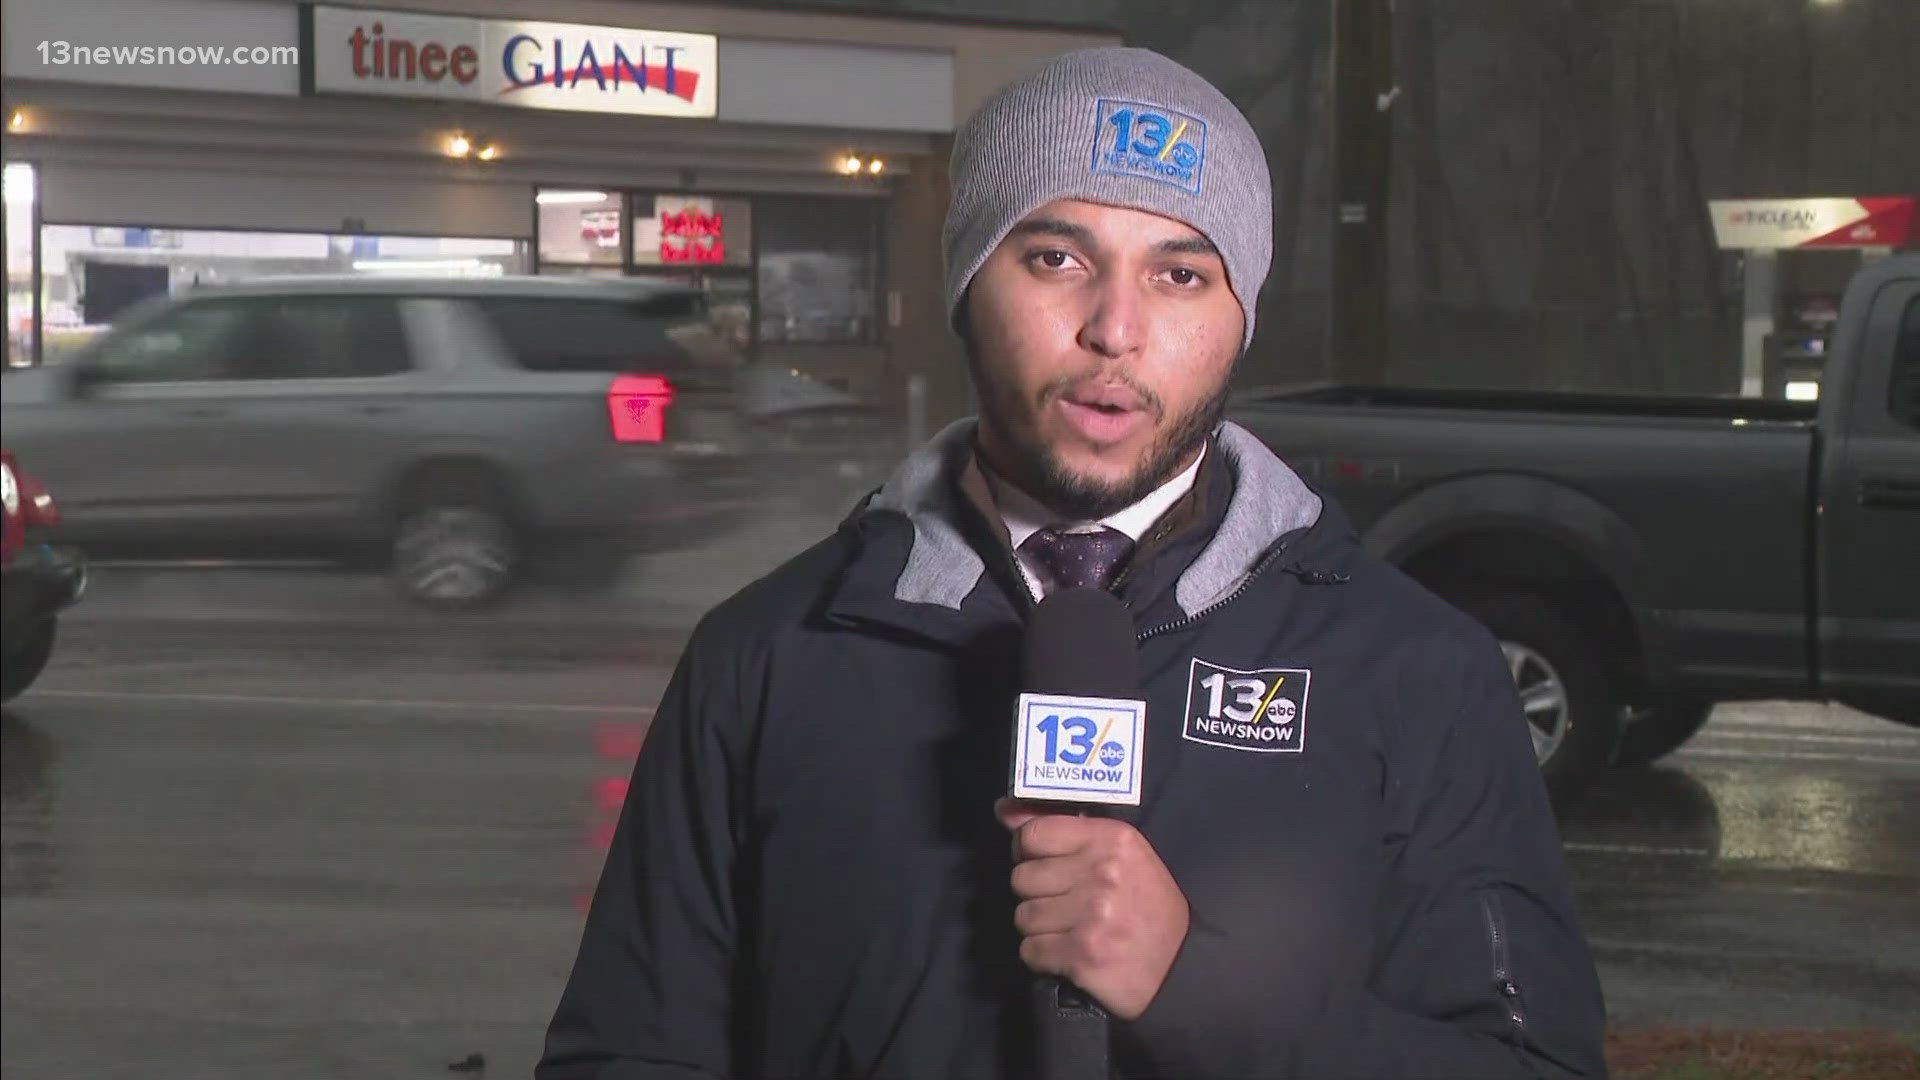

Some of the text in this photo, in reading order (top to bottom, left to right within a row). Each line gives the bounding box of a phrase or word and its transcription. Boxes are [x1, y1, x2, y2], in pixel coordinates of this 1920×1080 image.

[349, 21, 685, 95] tinee GIANT
[1110, 108, 1171, 157] 13
[1200, 672, 1267, 723] 13
[1036, 715, 1098, 765] 13
[1196, 716, 1293, 741] NEWSNOW
[1034, 765, 1123, 782] NEWSNOW
